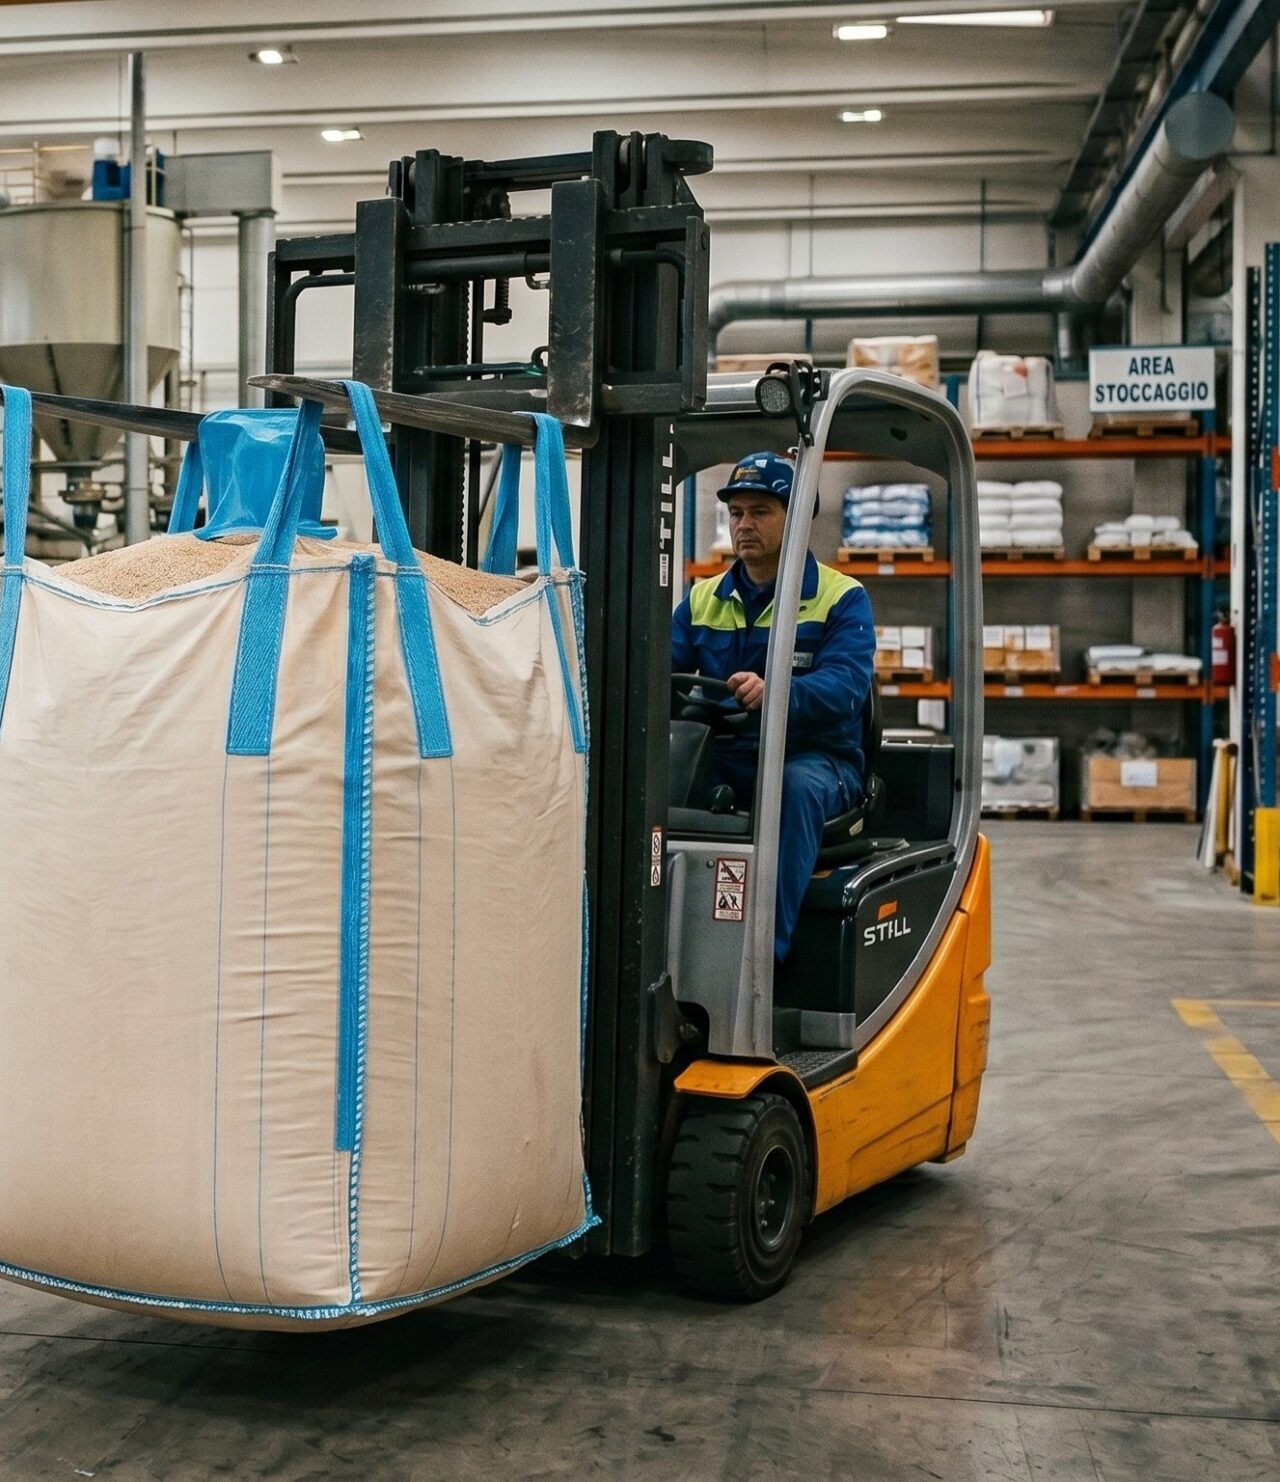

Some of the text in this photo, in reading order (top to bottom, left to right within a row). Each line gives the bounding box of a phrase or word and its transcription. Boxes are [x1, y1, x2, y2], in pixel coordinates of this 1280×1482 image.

[1128, 356, 1174, 375] AREA
[1095, 381, 1208, 403] STOCCAGGIO
[659, 443, 673, 550] TILL
[863, 916, 911, 947] STILL
